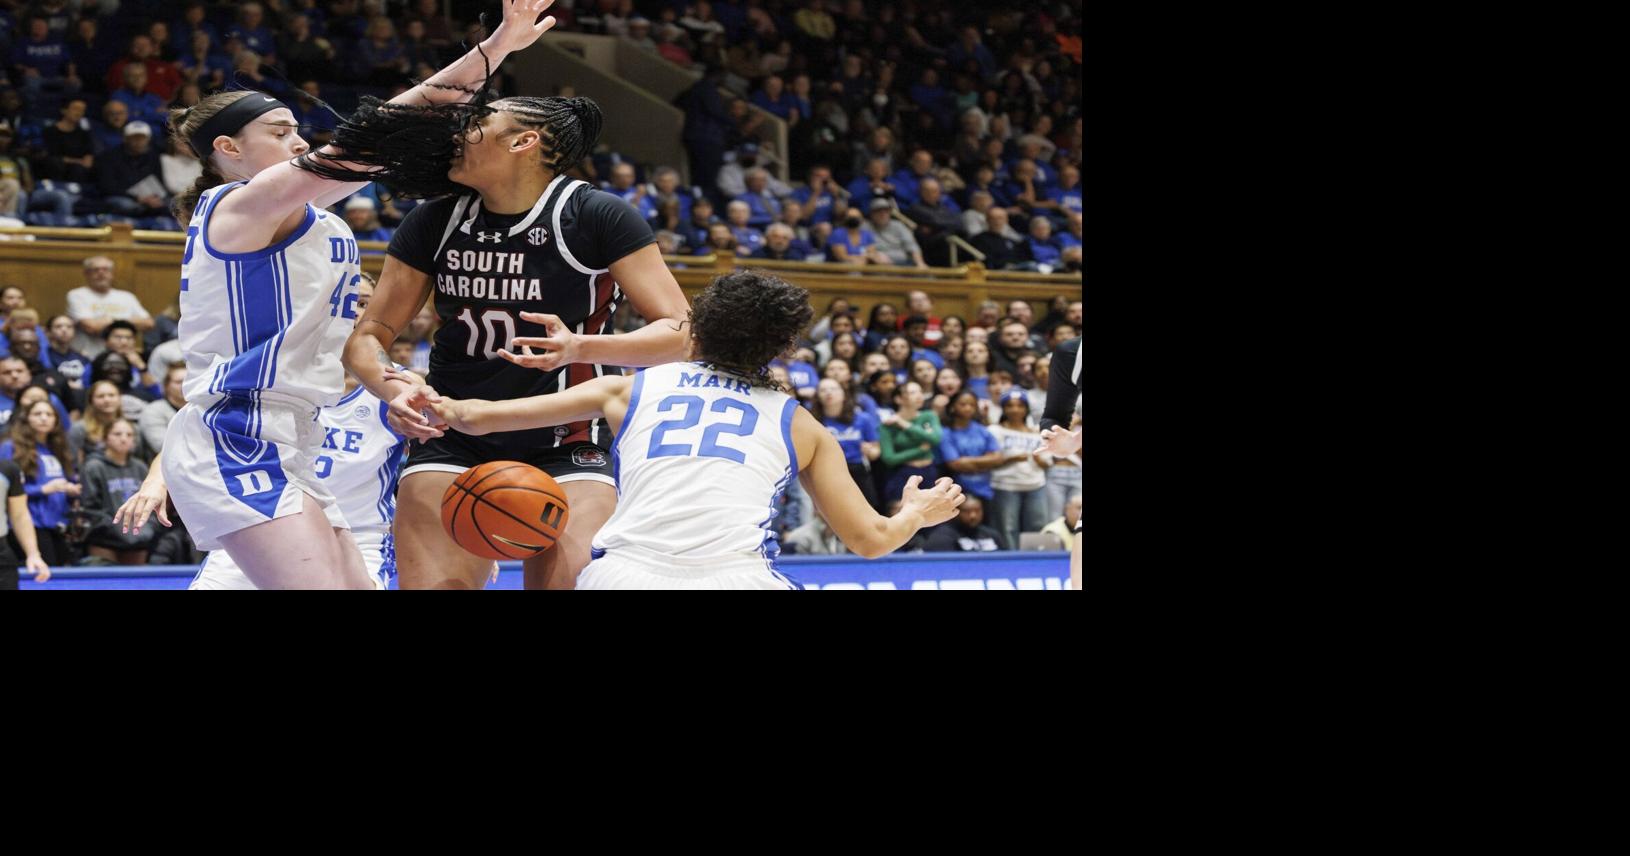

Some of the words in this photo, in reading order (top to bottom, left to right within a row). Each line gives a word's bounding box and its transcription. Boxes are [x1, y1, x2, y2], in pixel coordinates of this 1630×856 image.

[527, 226, 548, 246] SEC
[446, 249, 525, 275] SOUTH
[328, 271, 361, 320] 42
[437, 273, 543, 301] CAROLINA
[457, 307, 517, 361] 10
[676, 371, 752, 396] MAIR
[647, 394, 760, 465] 22
